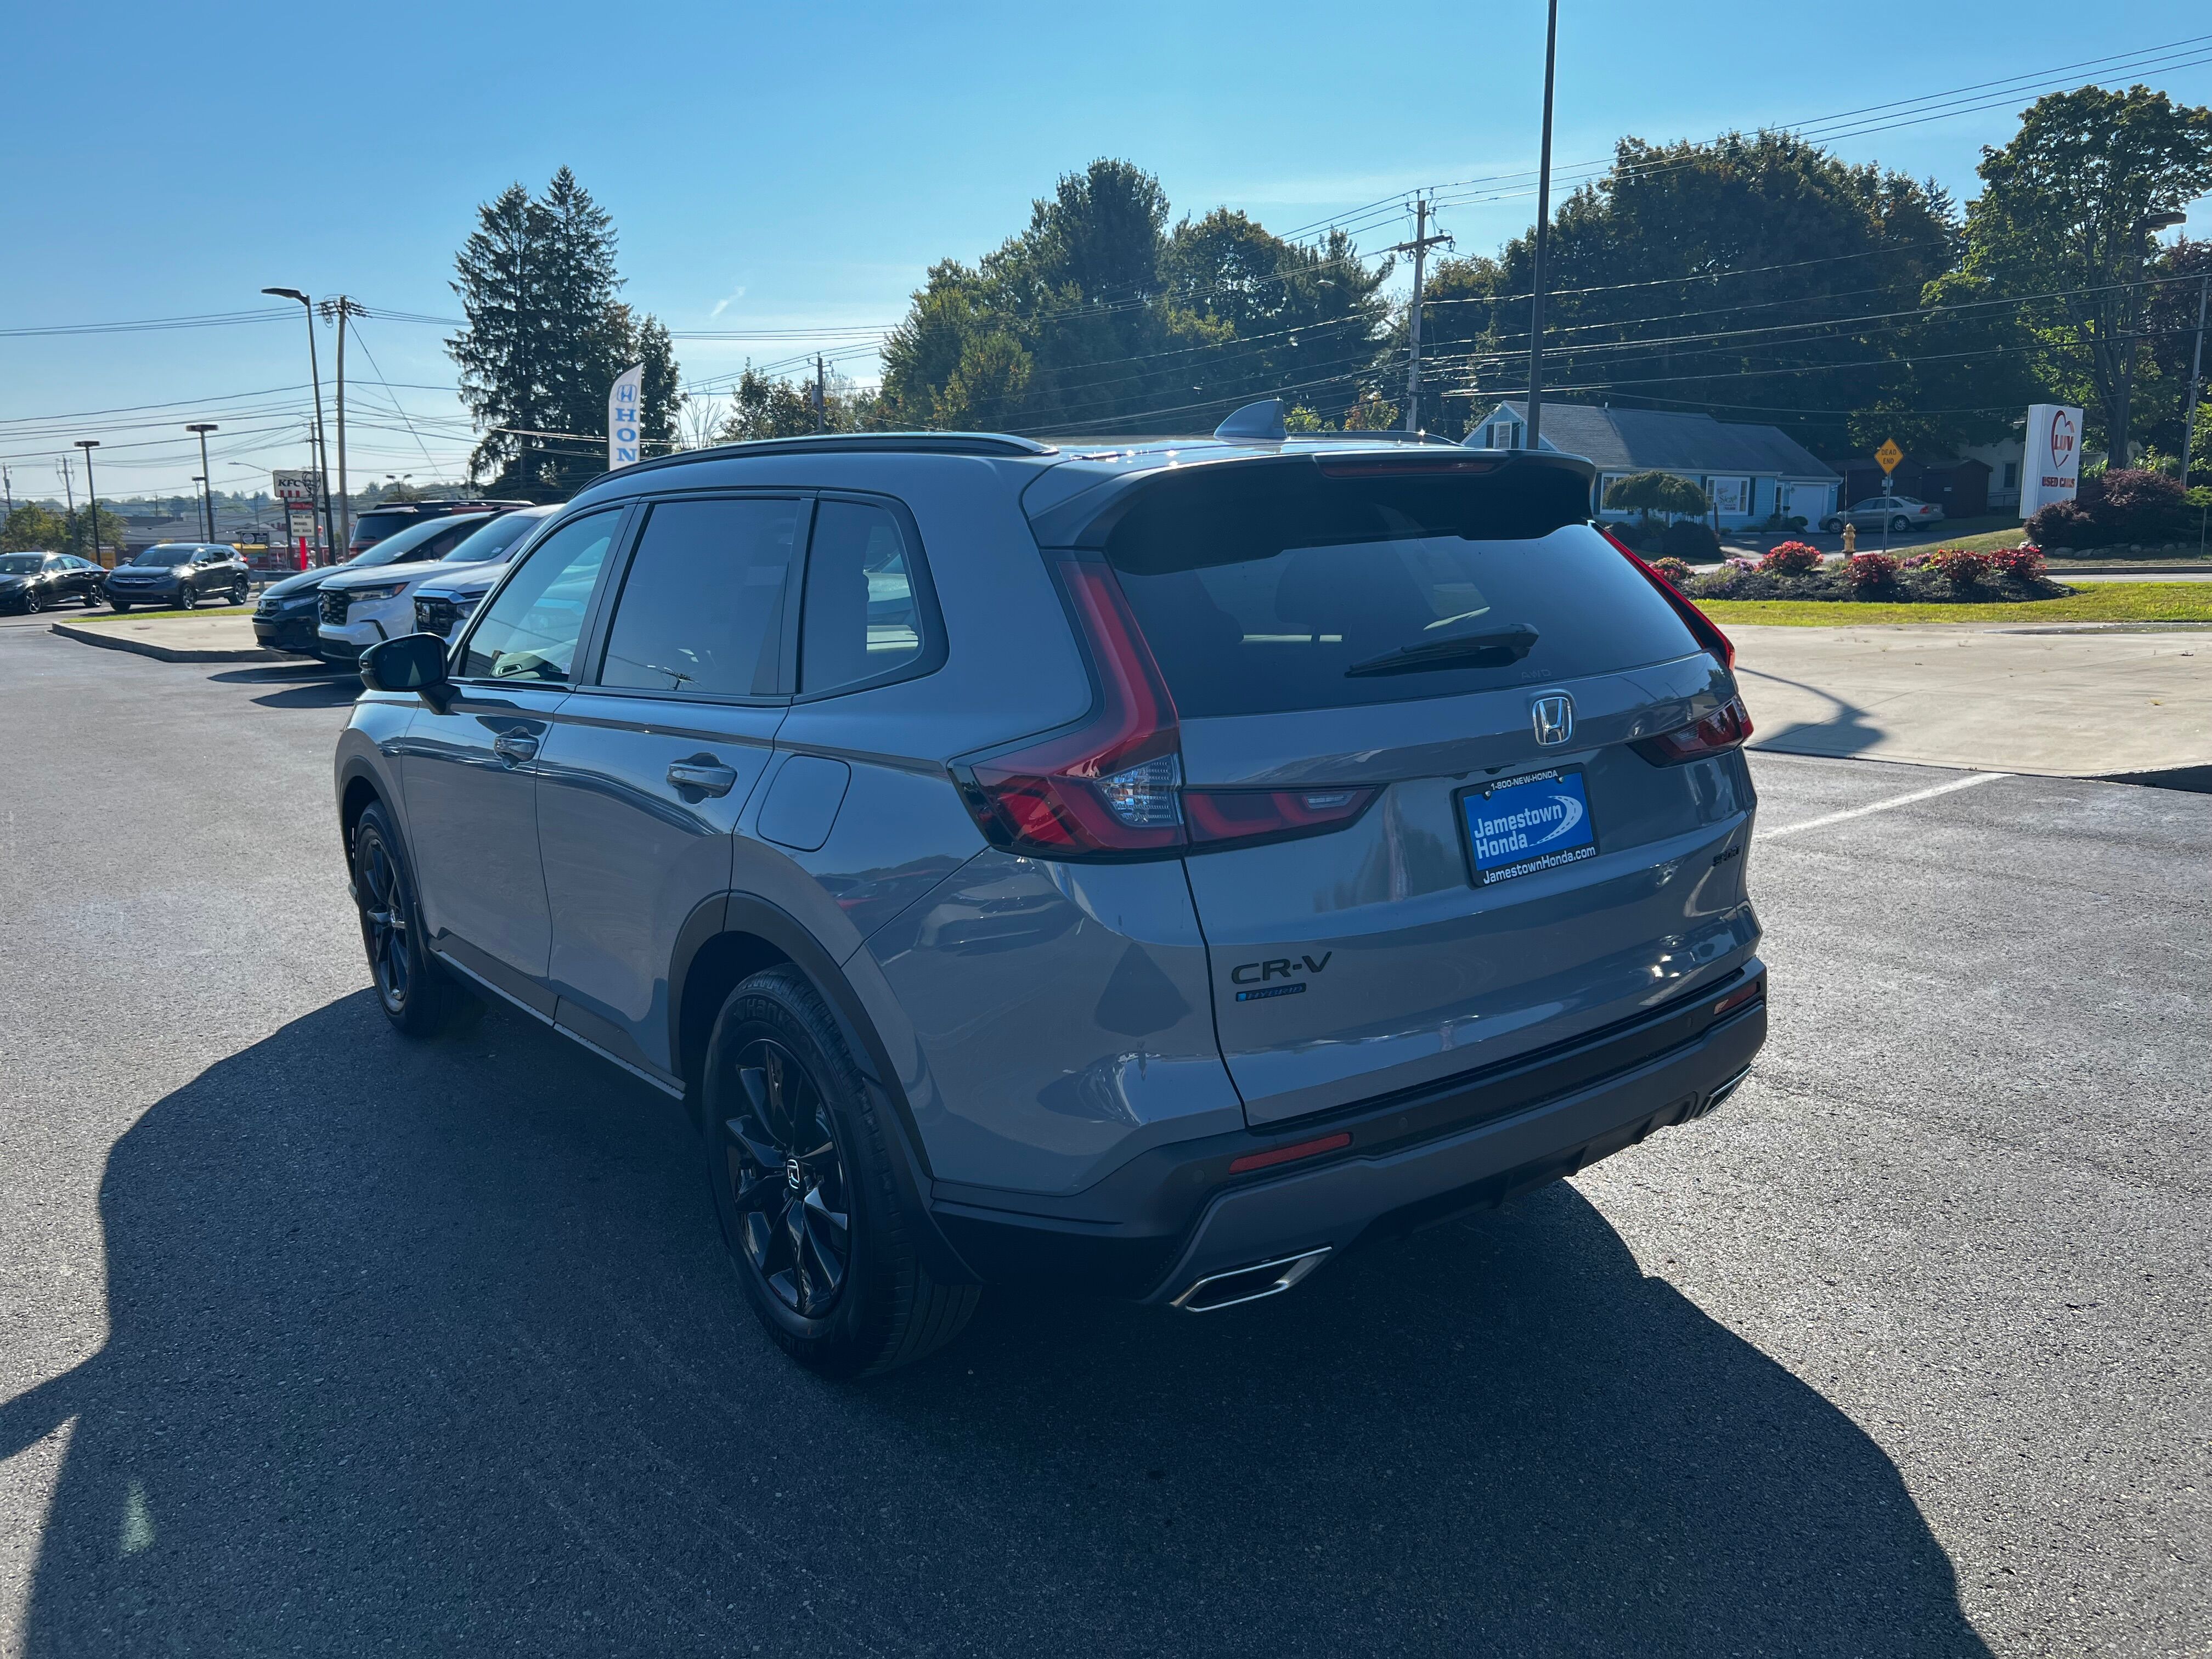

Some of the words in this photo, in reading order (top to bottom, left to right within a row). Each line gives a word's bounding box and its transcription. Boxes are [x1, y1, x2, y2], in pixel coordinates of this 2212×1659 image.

[2053, 435, 2074, 451] LUV
[2042, 476, 2058, 487] USED
[2059, 477, 2075, 488] CARS
[1490, 770, 1558, 791] 1-800-NEW-HONDA
[1474, 804, 1562, 838] Jamestown
[1476, 831, 1528, 860] Honda
[1483, 846, 1596, 885] JamestownHonda.com
[1231, 951, 1333, 985] CR-V
[1248, 985, 1303, 1000] HYBRID
